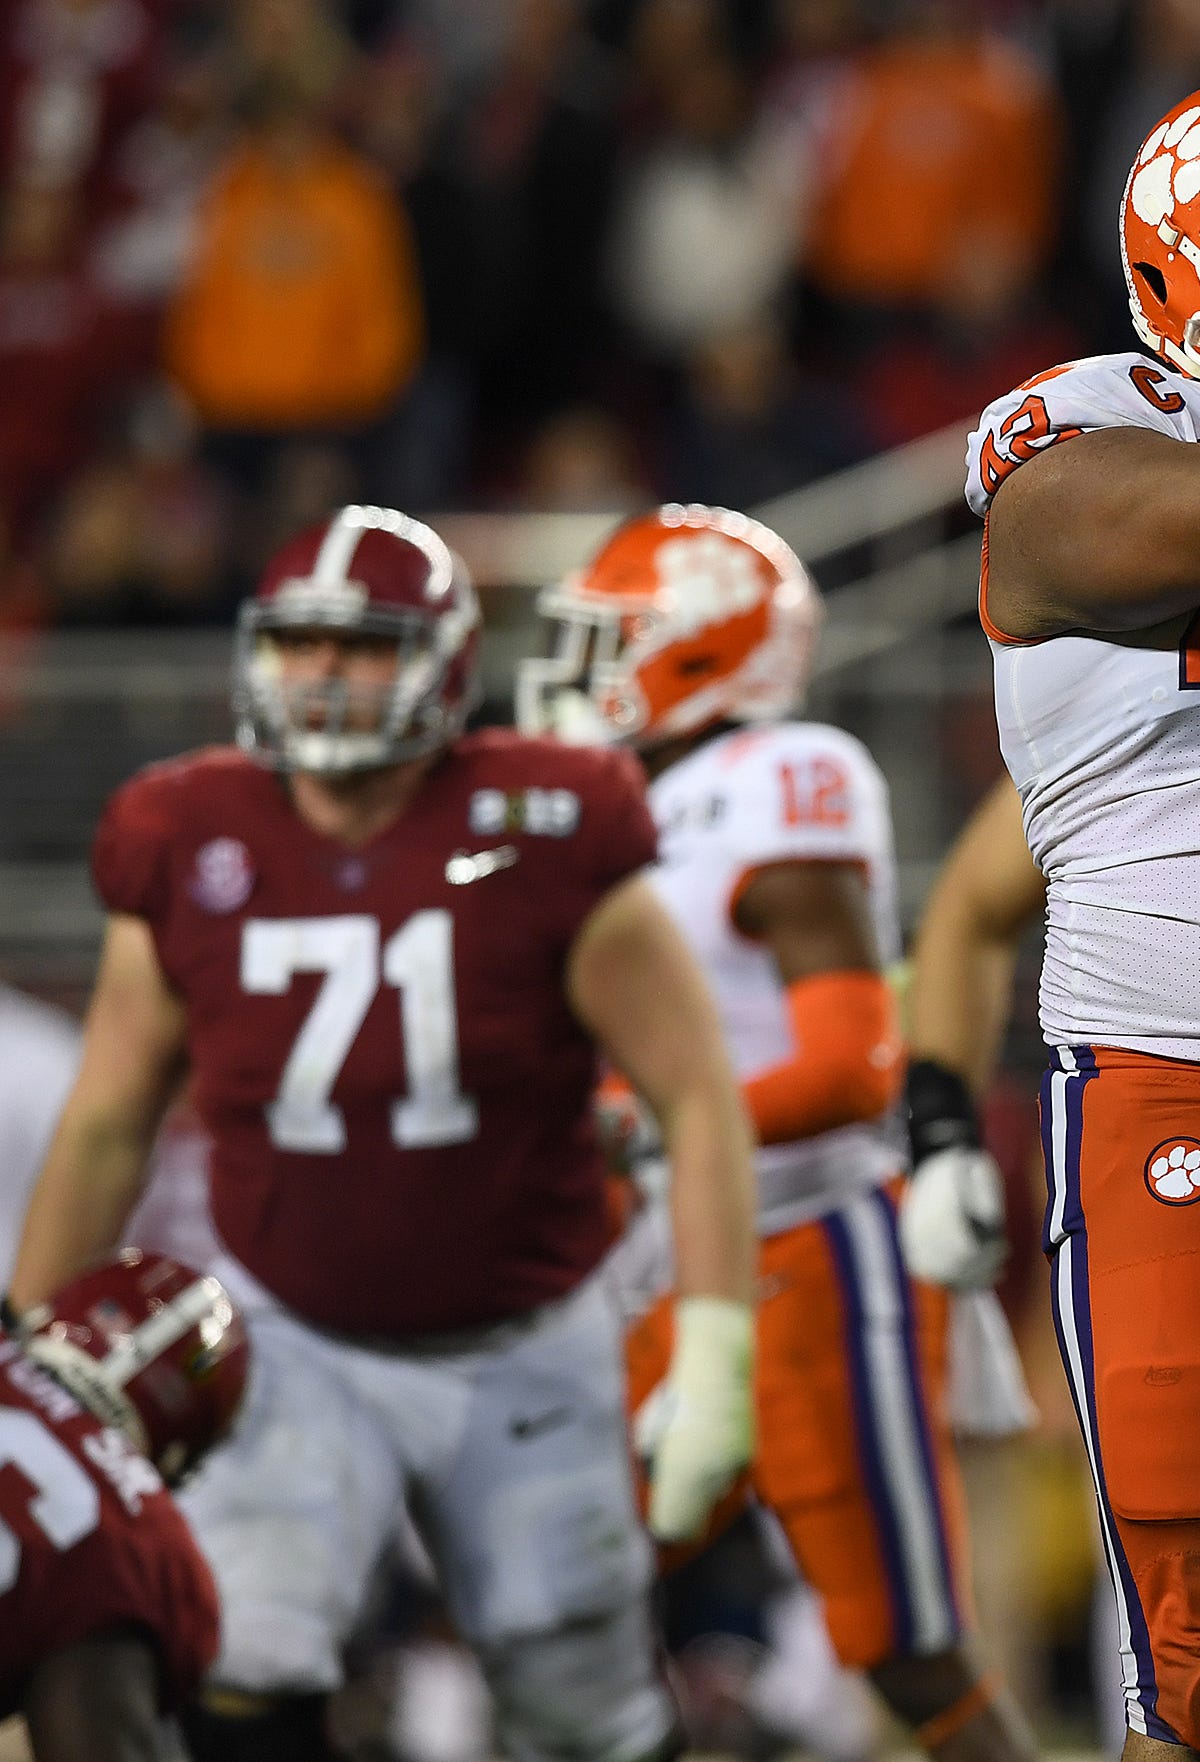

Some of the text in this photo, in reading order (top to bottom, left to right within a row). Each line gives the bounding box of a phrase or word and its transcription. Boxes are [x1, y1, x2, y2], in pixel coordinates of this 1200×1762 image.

[1128, 365, 1186, 414] C
[776, 757, 849, 828] 12
[240, 907, 481, 1155] 71
